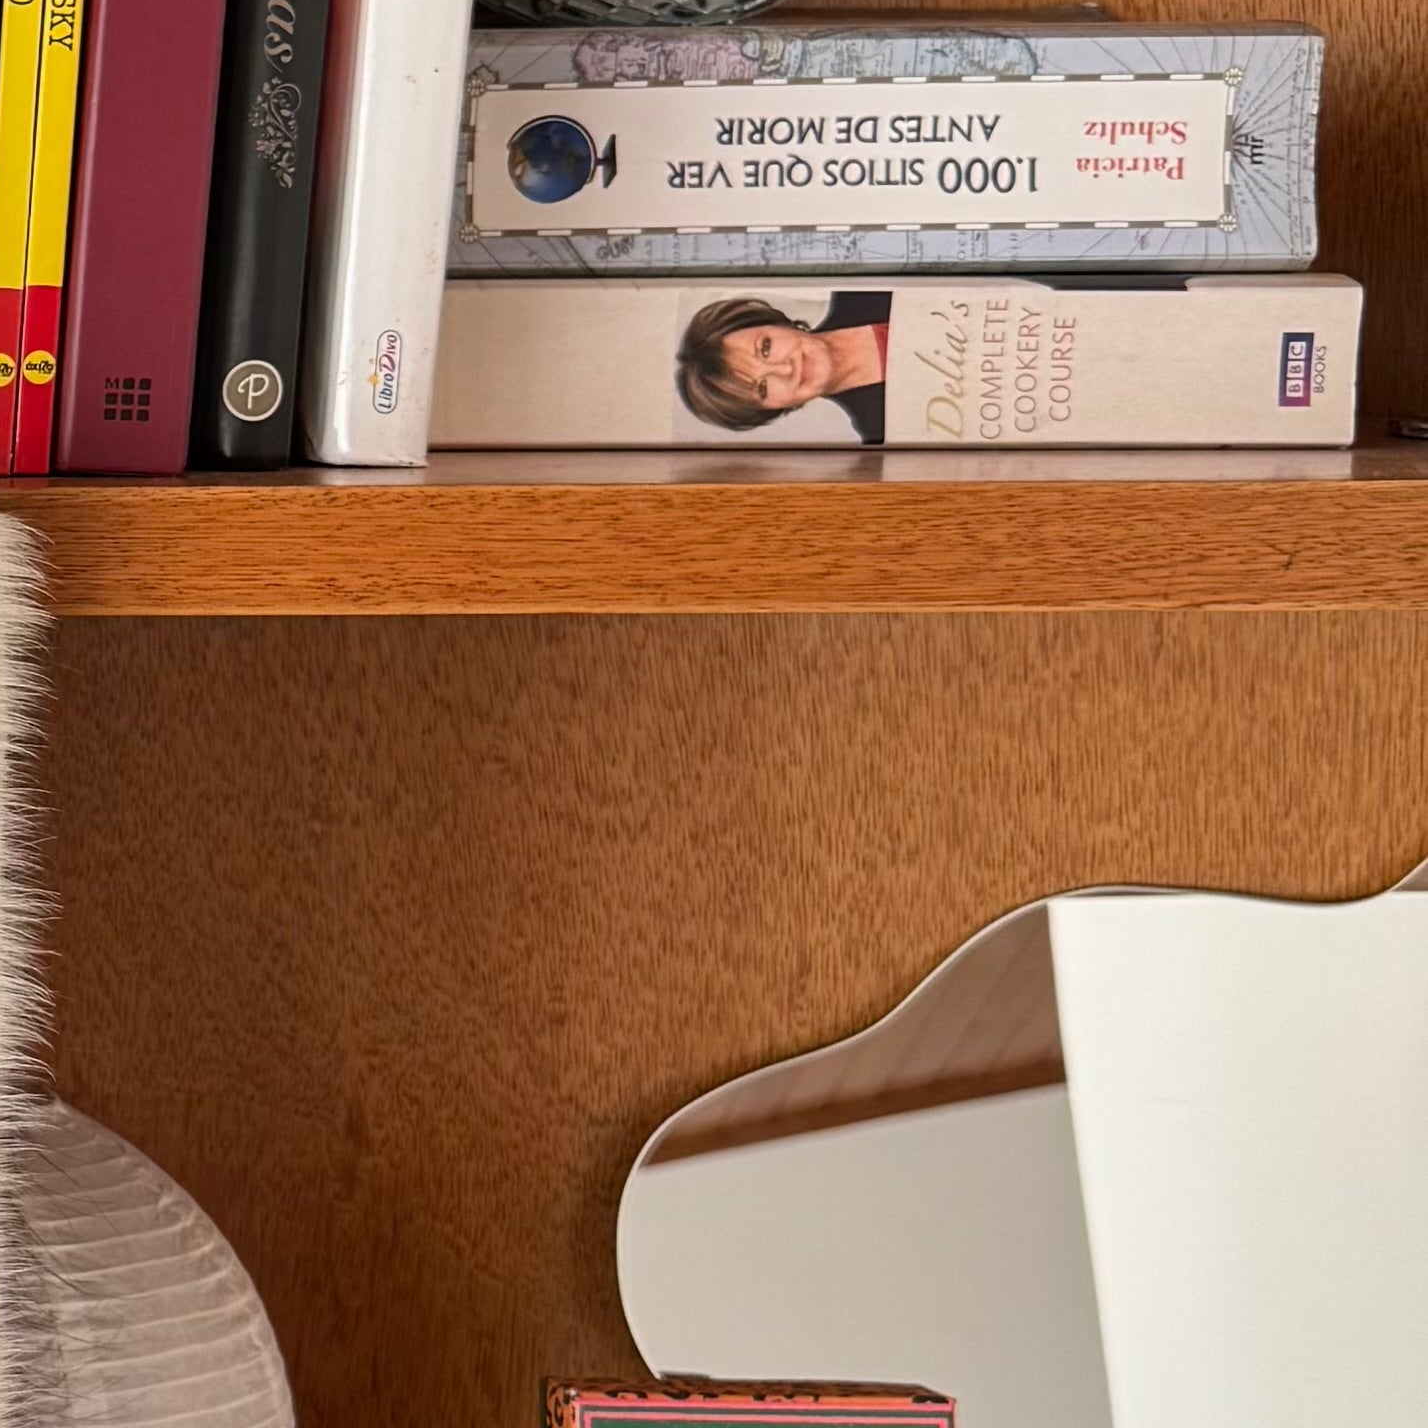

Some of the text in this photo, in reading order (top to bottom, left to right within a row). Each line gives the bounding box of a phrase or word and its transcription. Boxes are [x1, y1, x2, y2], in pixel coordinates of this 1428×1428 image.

[715, 115, 1002, 146] ANTES DE MORIR
[1082, 119, 1188, 145] Schultz
[667, 153, 1040, 195] 1.000 SITIOS QUE VER
[1075, 156, 1185, 181] Patricia
[915, 300, 970, 439] Delia's
[980, 299, 1010, 440] COMPLETE
[1014, 306, 1042, 433] COOKERY
[1049, 316, 1077, 422] COURSE
[1286, 341, 1306, 398] BBC
[1314, 345, 1327, 394] BOOKS
